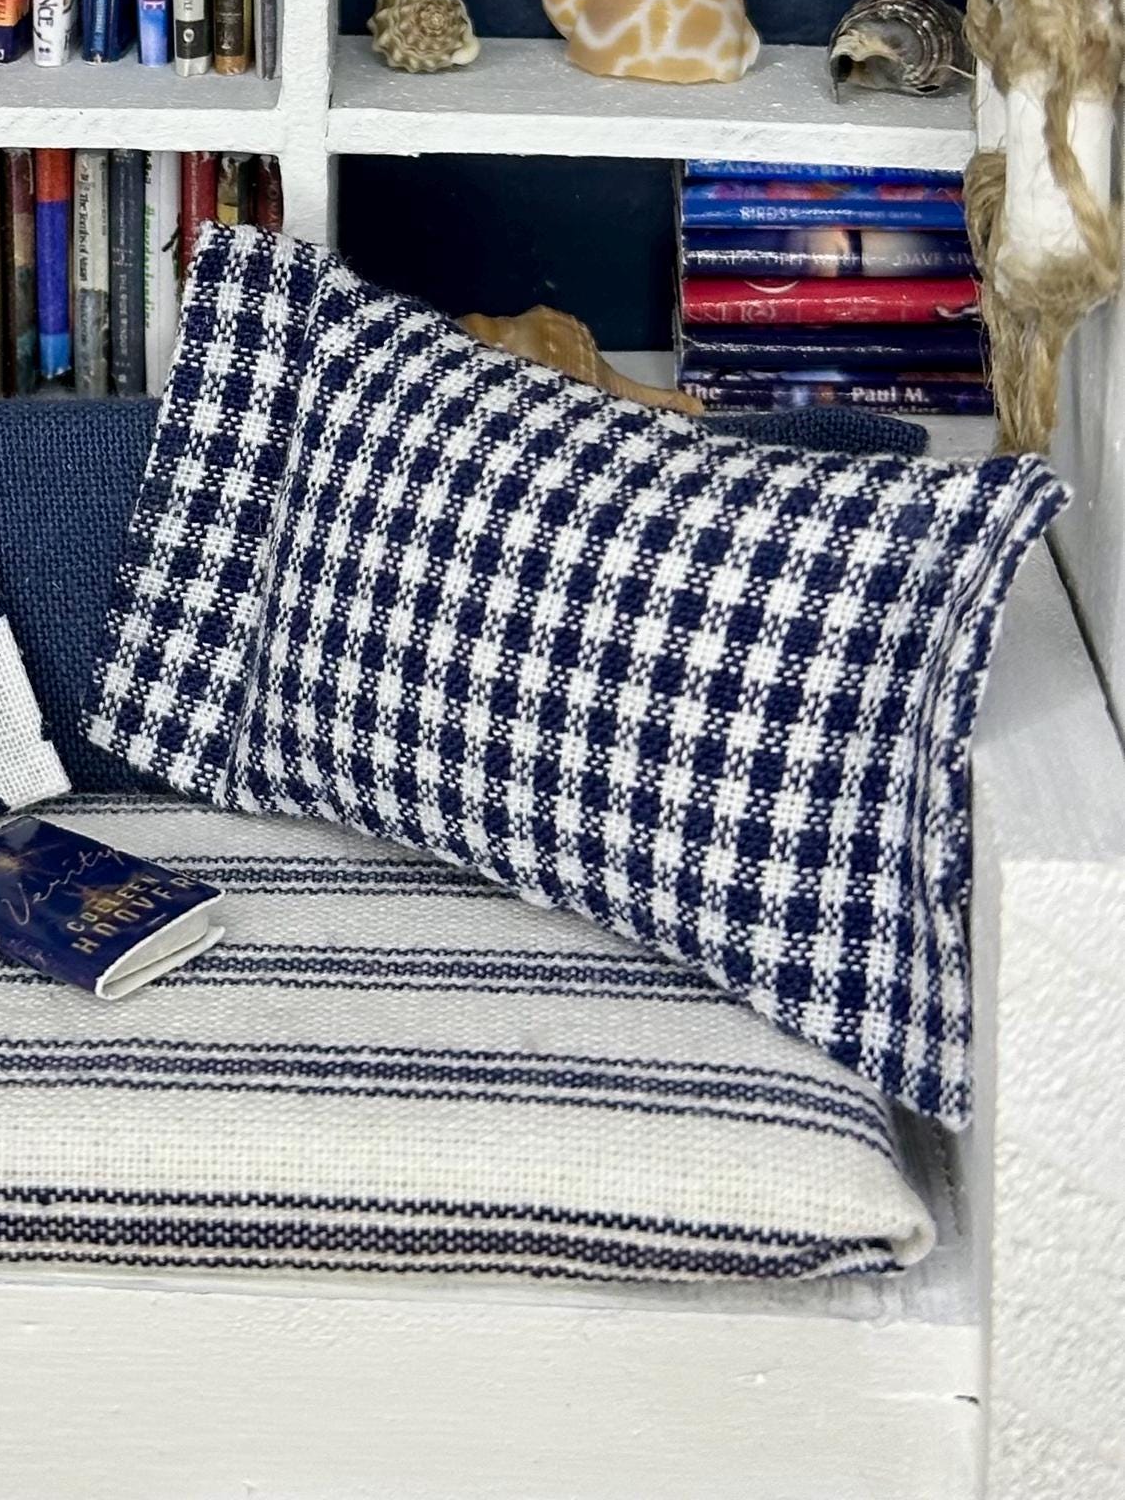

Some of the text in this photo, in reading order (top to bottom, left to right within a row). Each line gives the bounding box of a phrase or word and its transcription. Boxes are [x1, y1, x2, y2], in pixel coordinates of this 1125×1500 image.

[79, 192, 90, 210] The
[683, 382, 722, 401] The
[851, 386, 930, 403] Paul M.
[1, 847, 125, 926] Verity
[66, 873, 160, 933] COLLEEN
[71, 876, 198, 954] HOOVER
